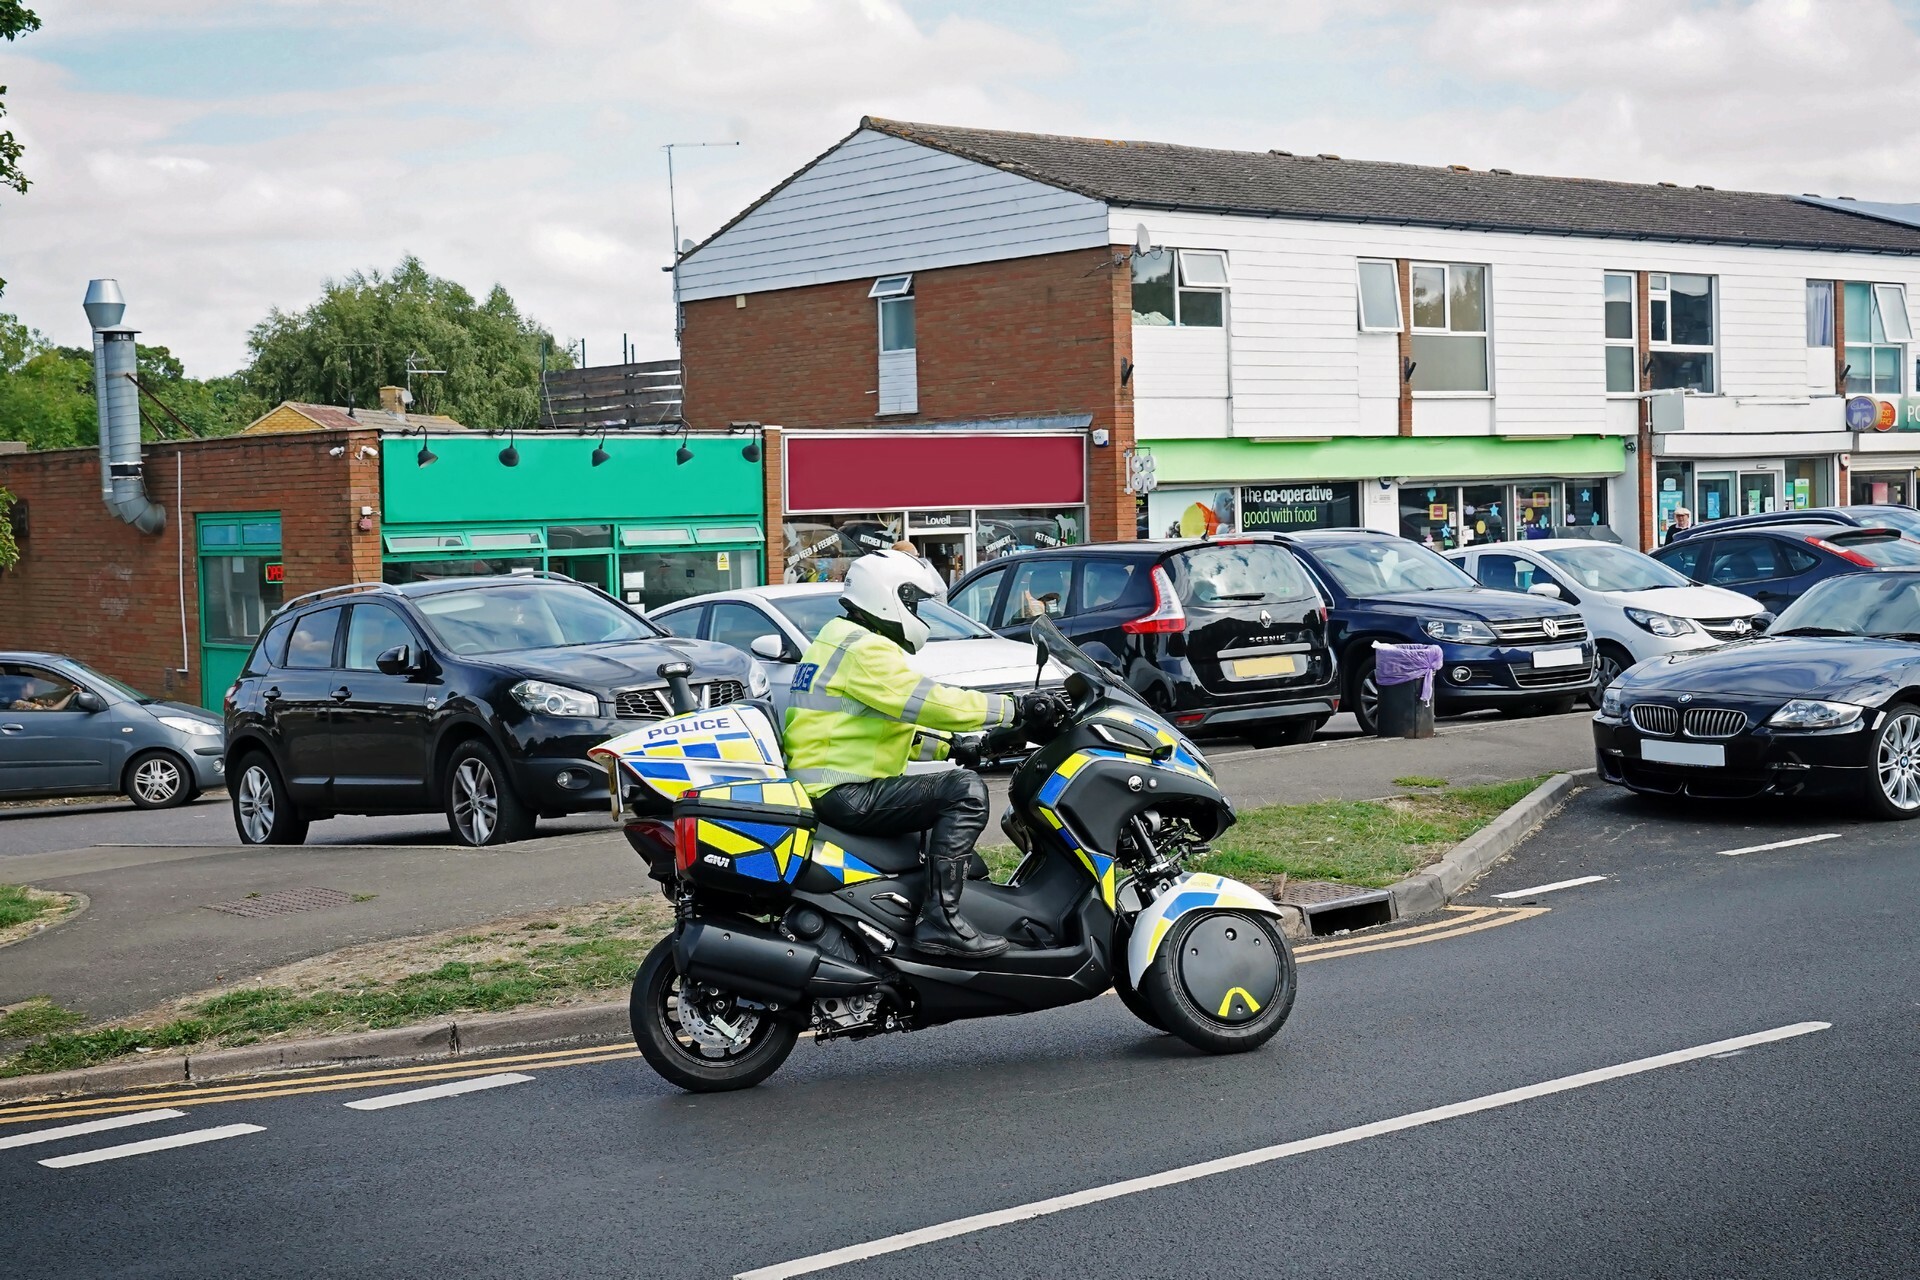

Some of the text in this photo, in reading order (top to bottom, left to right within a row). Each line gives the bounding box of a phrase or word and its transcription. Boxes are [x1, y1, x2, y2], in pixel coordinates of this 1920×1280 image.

[1880, 409, 1892, 417] OST
[1243, 485, 1333, 505] The co-operative
[925, 515, 951, 525] Lovell
[1243, 506, 1317, 528] good with food
[985, 535, 1012, 553] STATIONERY
[1034, 531, 1044, 541] PET
[1043, 535, 1056, 544] FOOD
[799, 546, 813, 560] FEED
[812, 544, 819, 553] &
[818, 534, 840, 549] FEEDERS
[267, 565, 284, 581] OPE
[1249, 634, 1286, 643] SCENIC
[648, 718, 730, 739] POLICE
[703, 853, 730, 868] GIVI
